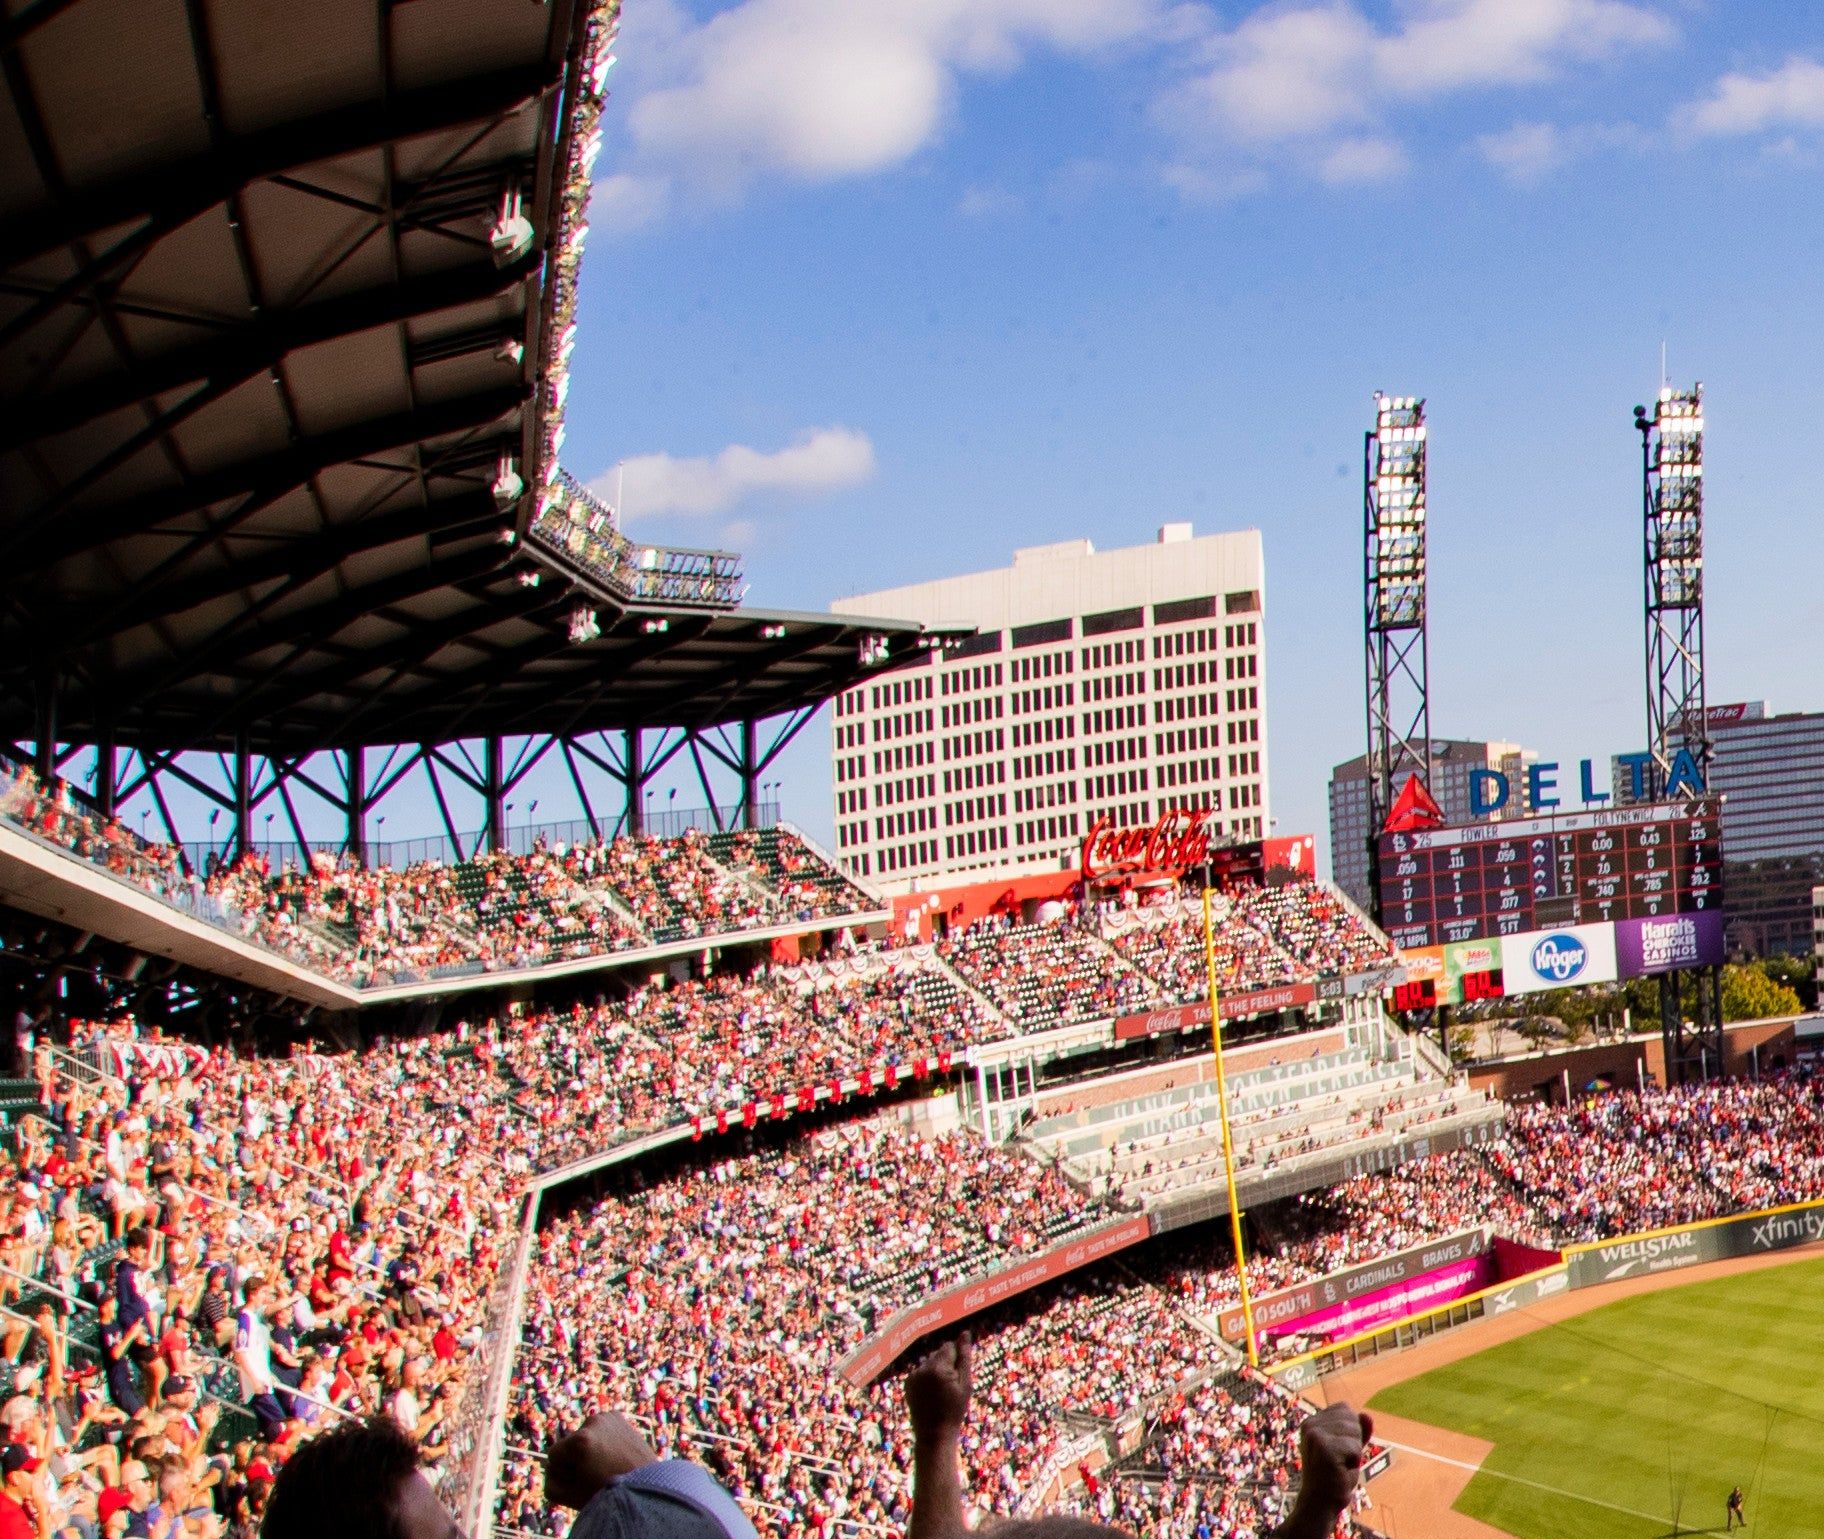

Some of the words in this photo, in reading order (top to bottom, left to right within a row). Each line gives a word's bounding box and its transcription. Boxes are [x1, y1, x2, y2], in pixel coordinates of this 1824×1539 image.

[1688, 706, 1739, 723] RaeTrac
[1470, 750, 1706, 815] DELTA
[1594, 808, 1655, 826] FOLTYNEWICZ
[1083, 808, 1213, 878] Coca-Cola
[1420, 834, 1432, 847] 25
[1461, 826, 1498, 841] FOWLER
[1592, 839, 1612, 850] 0.00
[1640, 833, 1660, 845] 0.43
[1449, 856, 1464, 869] .111
[1648, 858, 1654, 868] 0
[1403, 888, 1412, 899] 17
[1504, 875, 1510, 886] 4
[1650, 903, 1657, 915] 0
[1697, 898, 1703, 909] 0
[1405, 911, 1412, 922] 0
[1507, 920, 1518, 932] FT
[1641, 919, 1696, 941] Harrah's
[1406, 934, 1427, 947] MPH
[1641, 934, 1697, 951] CHEROKEE
[1535, 940, 1584, 980] Kroger
[1643, 946, 1697, 961] CASINOS
[1193, 1003, 1224, 1019] TASE
[1227, 998, 1248, 1013] THE
[1251, 990, 1293, 1011] FEELING
[1321, 982, 1342, 998] 5:03
[1600, 1232, 1696, 1263] WELLSTAR
[1268, 1293, 1311, 1320] SOUTH
[1346, 1262, 1405, 1293] CARDINALS
[1422, 1243, 1462, 1267] BRAVES
